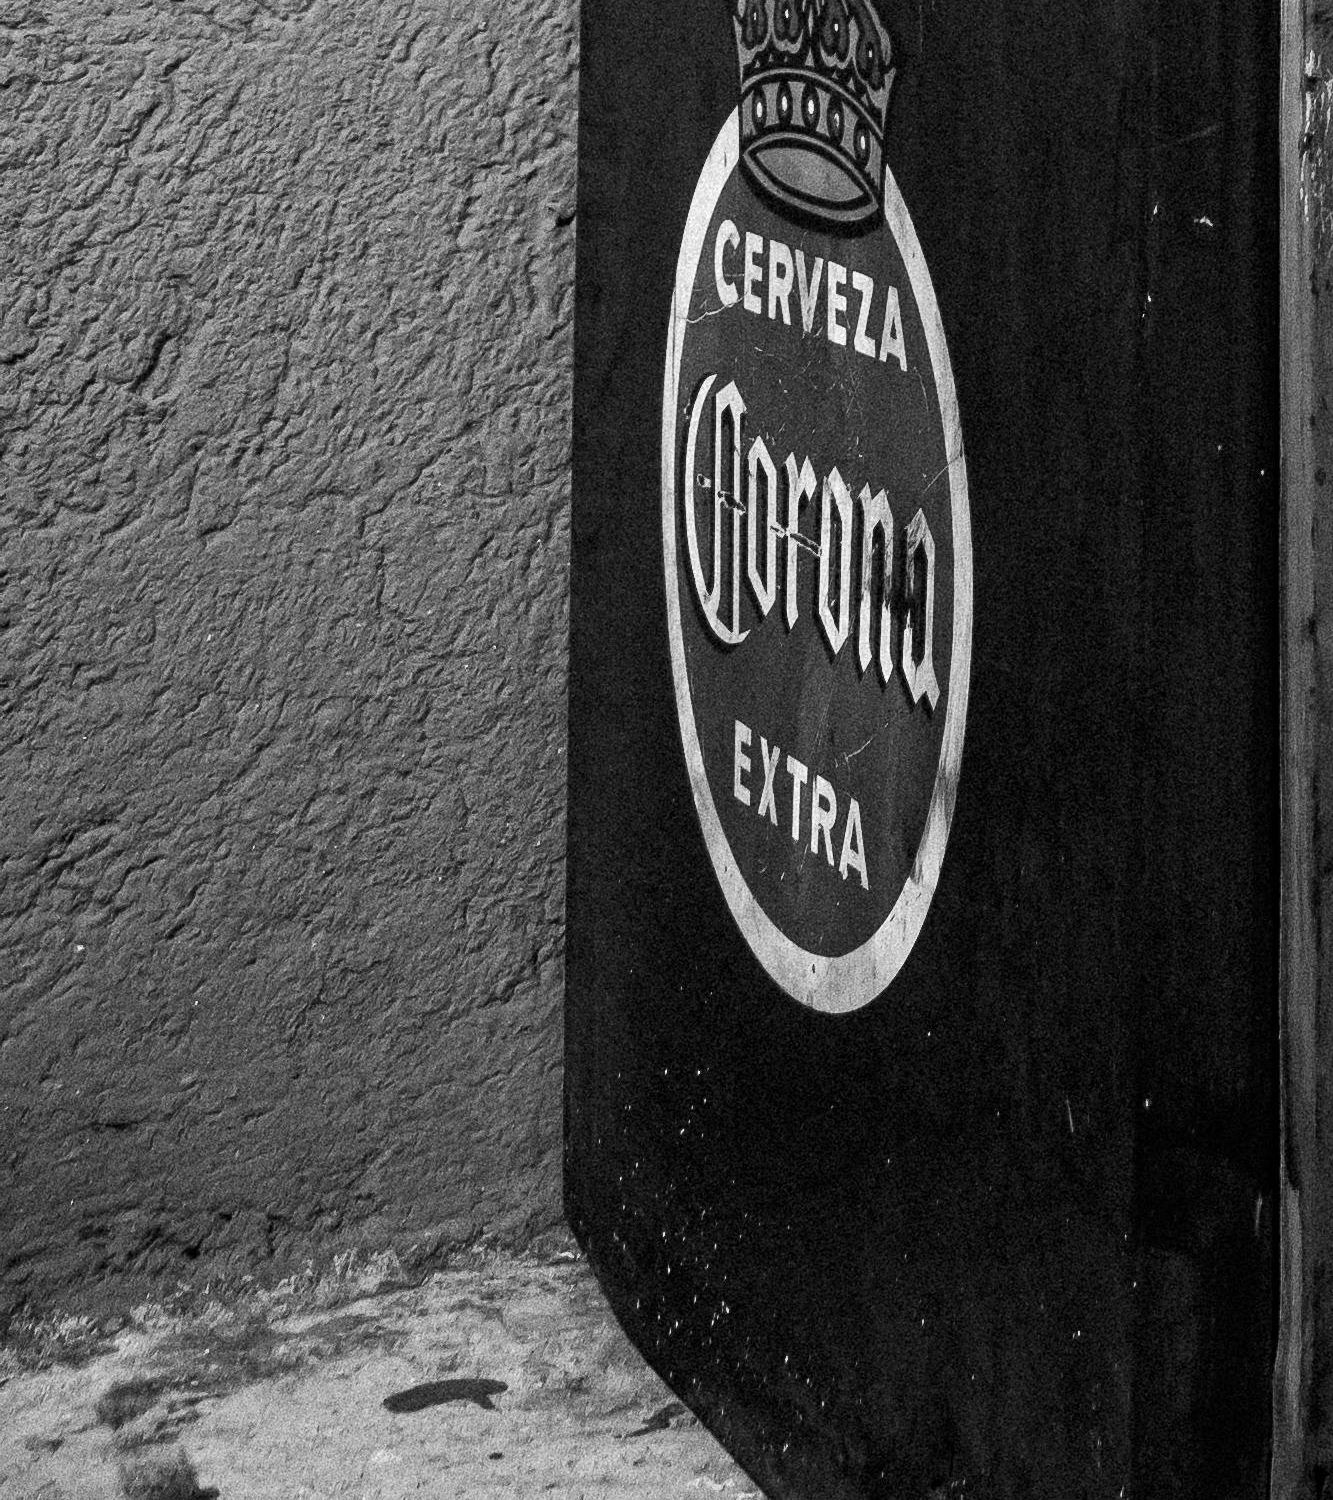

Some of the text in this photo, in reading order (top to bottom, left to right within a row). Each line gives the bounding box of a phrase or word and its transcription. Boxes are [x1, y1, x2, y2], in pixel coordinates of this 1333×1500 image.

[713, 218, 907, 372] CERVEZA
[685, 373, 941, 712] Corona
[732, 718, 870, 888] EXTRA
